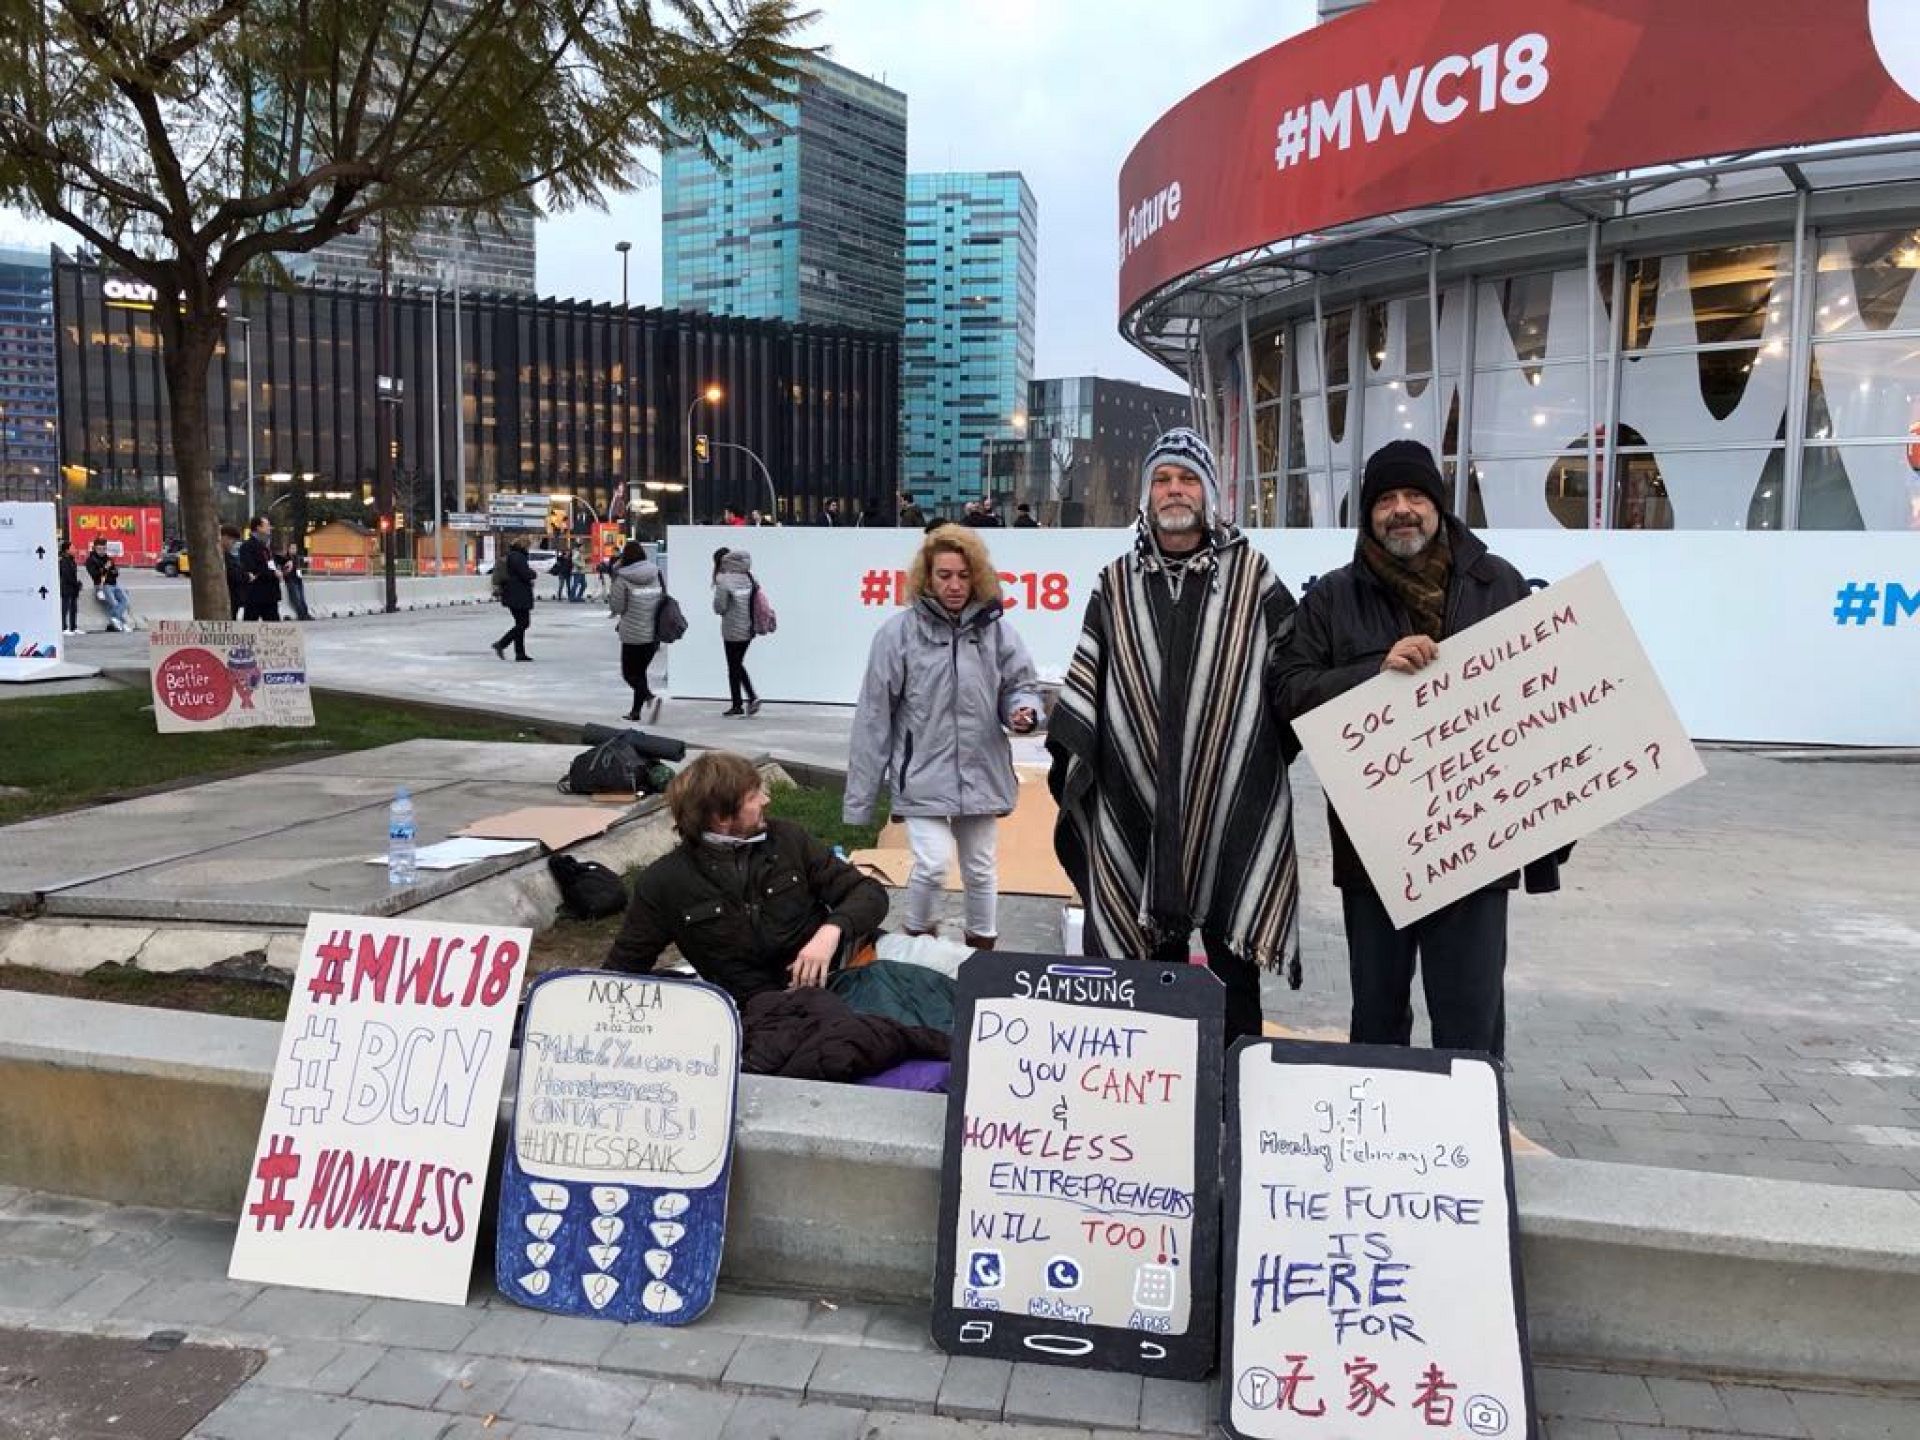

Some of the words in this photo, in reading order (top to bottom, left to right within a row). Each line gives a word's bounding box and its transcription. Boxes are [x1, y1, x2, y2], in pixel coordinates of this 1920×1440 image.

[1275, 33, 1549, 170] #MWC18
[110, 514, 134, 530] OUT
[861, 569, 1069, 611] #C18
[166, 672, 209, 689] Better
[168, 690, 215, 707] Future
[1342, 704, 1395, 752] SOC
[1415, 671, 1449, 708] EN
[1462, 605, 1577, 681] GUILLEM
[1362, 745, 1414, 790] SOC
[1412, 694, 1502, 749] TECNIC
[1522, 665, 1559, 699] EN
[1407, 801, 1486, 855] SENSA
[308, 929, 520, 1008] #MWC18
[1013, 971, 1135, 1007] SAMSUNG
[588, 980, 663, 1009] NOKIA
[977, 1011, 1028, 1044] DO
[1050, 1021, 1147, 1059] WHAT
[281, 1014, 492, 1128] #BCN
[1080, 1064, 1181, 1104] CAN'T
[530, 1097, 633, 1133] CONTACT
[963, 1115, 1134, 1163] HOMELESS
[250, 1134, 473, 1243] #HOMELESS
[1262, 1184, 1329, 1220] THE
[1345, 1187, 1484, 1225] FUTURE
[970, 1209, 1051, 1242] WILL
[1327, 1232, 1393, 1261] IS
[1250, 1253, 1412, 1326] HERE
[1331, 1308, 1426, 1345] FOR
